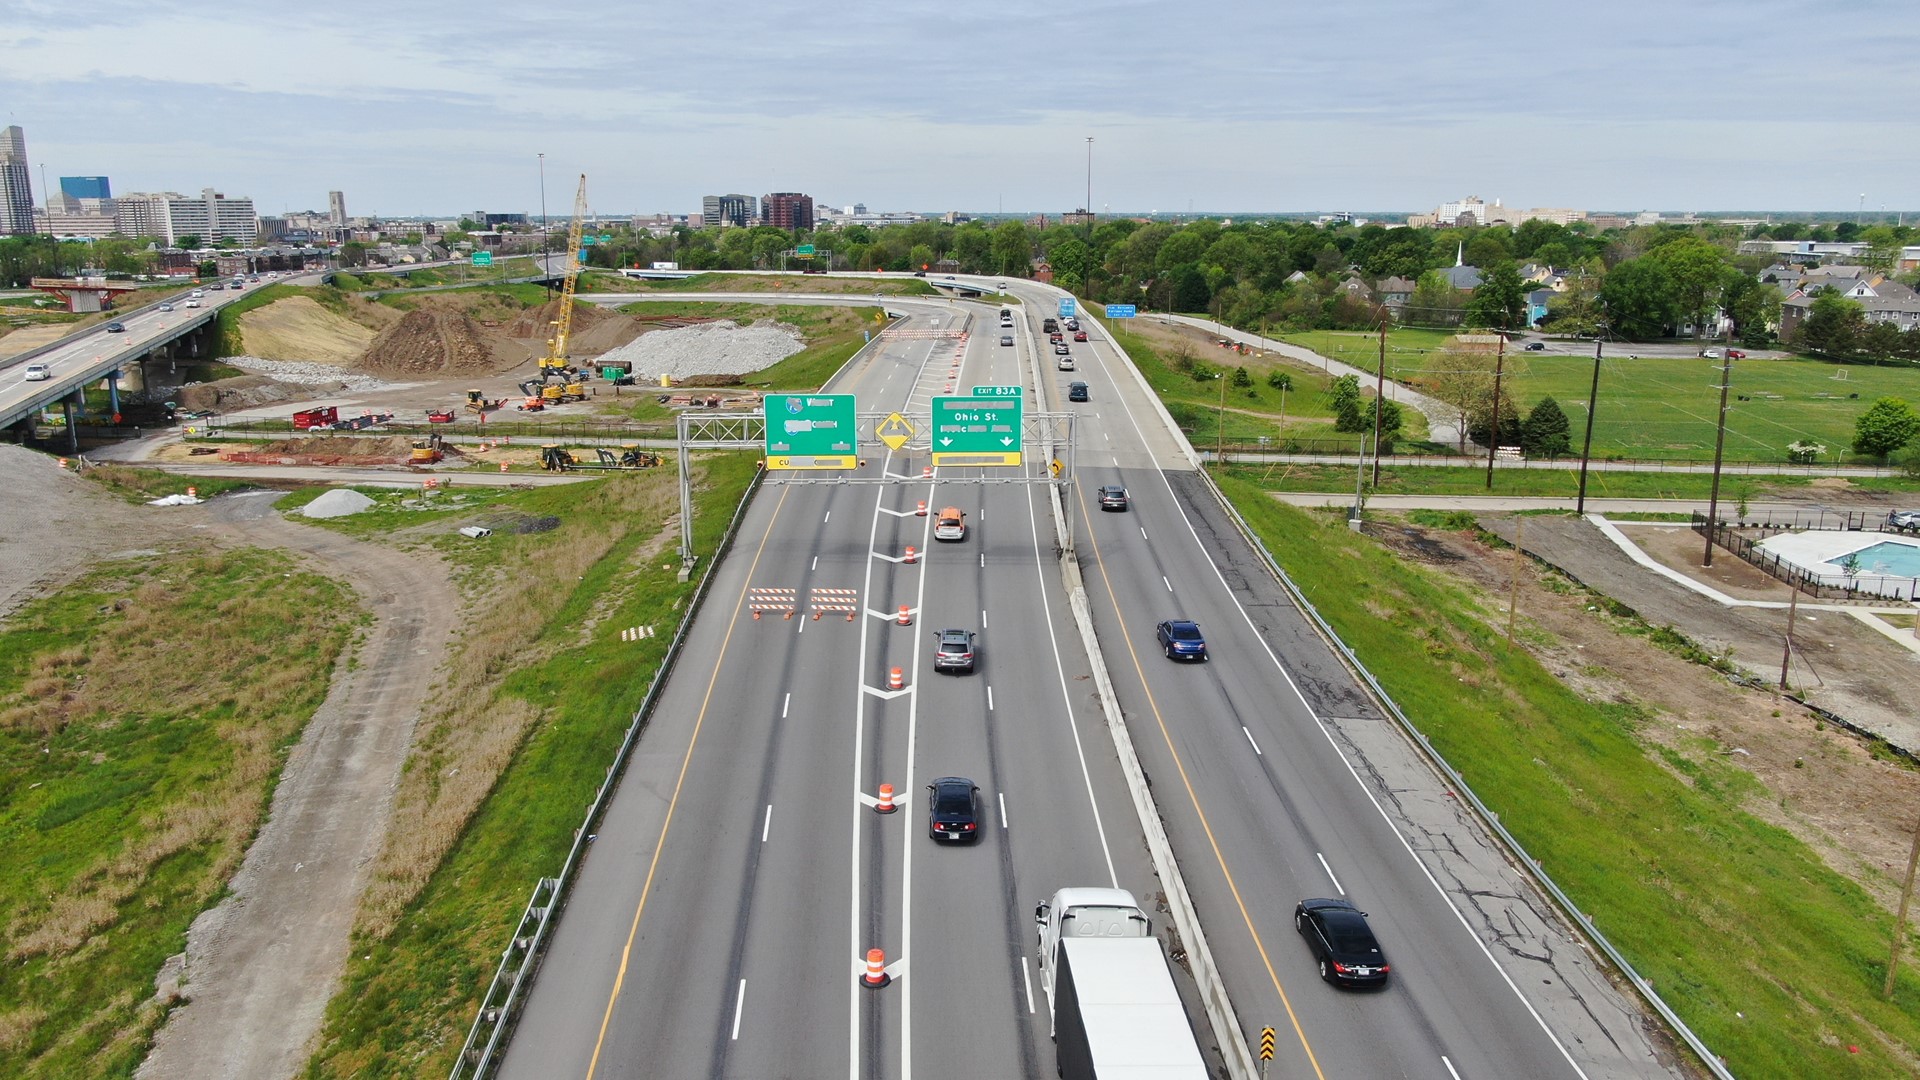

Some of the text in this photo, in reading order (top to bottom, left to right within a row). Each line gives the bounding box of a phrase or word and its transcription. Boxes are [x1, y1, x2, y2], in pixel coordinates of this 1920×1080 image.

[995, 387, 1016, 395] 83A
[954, 413, 999, 421] Ohio St.
